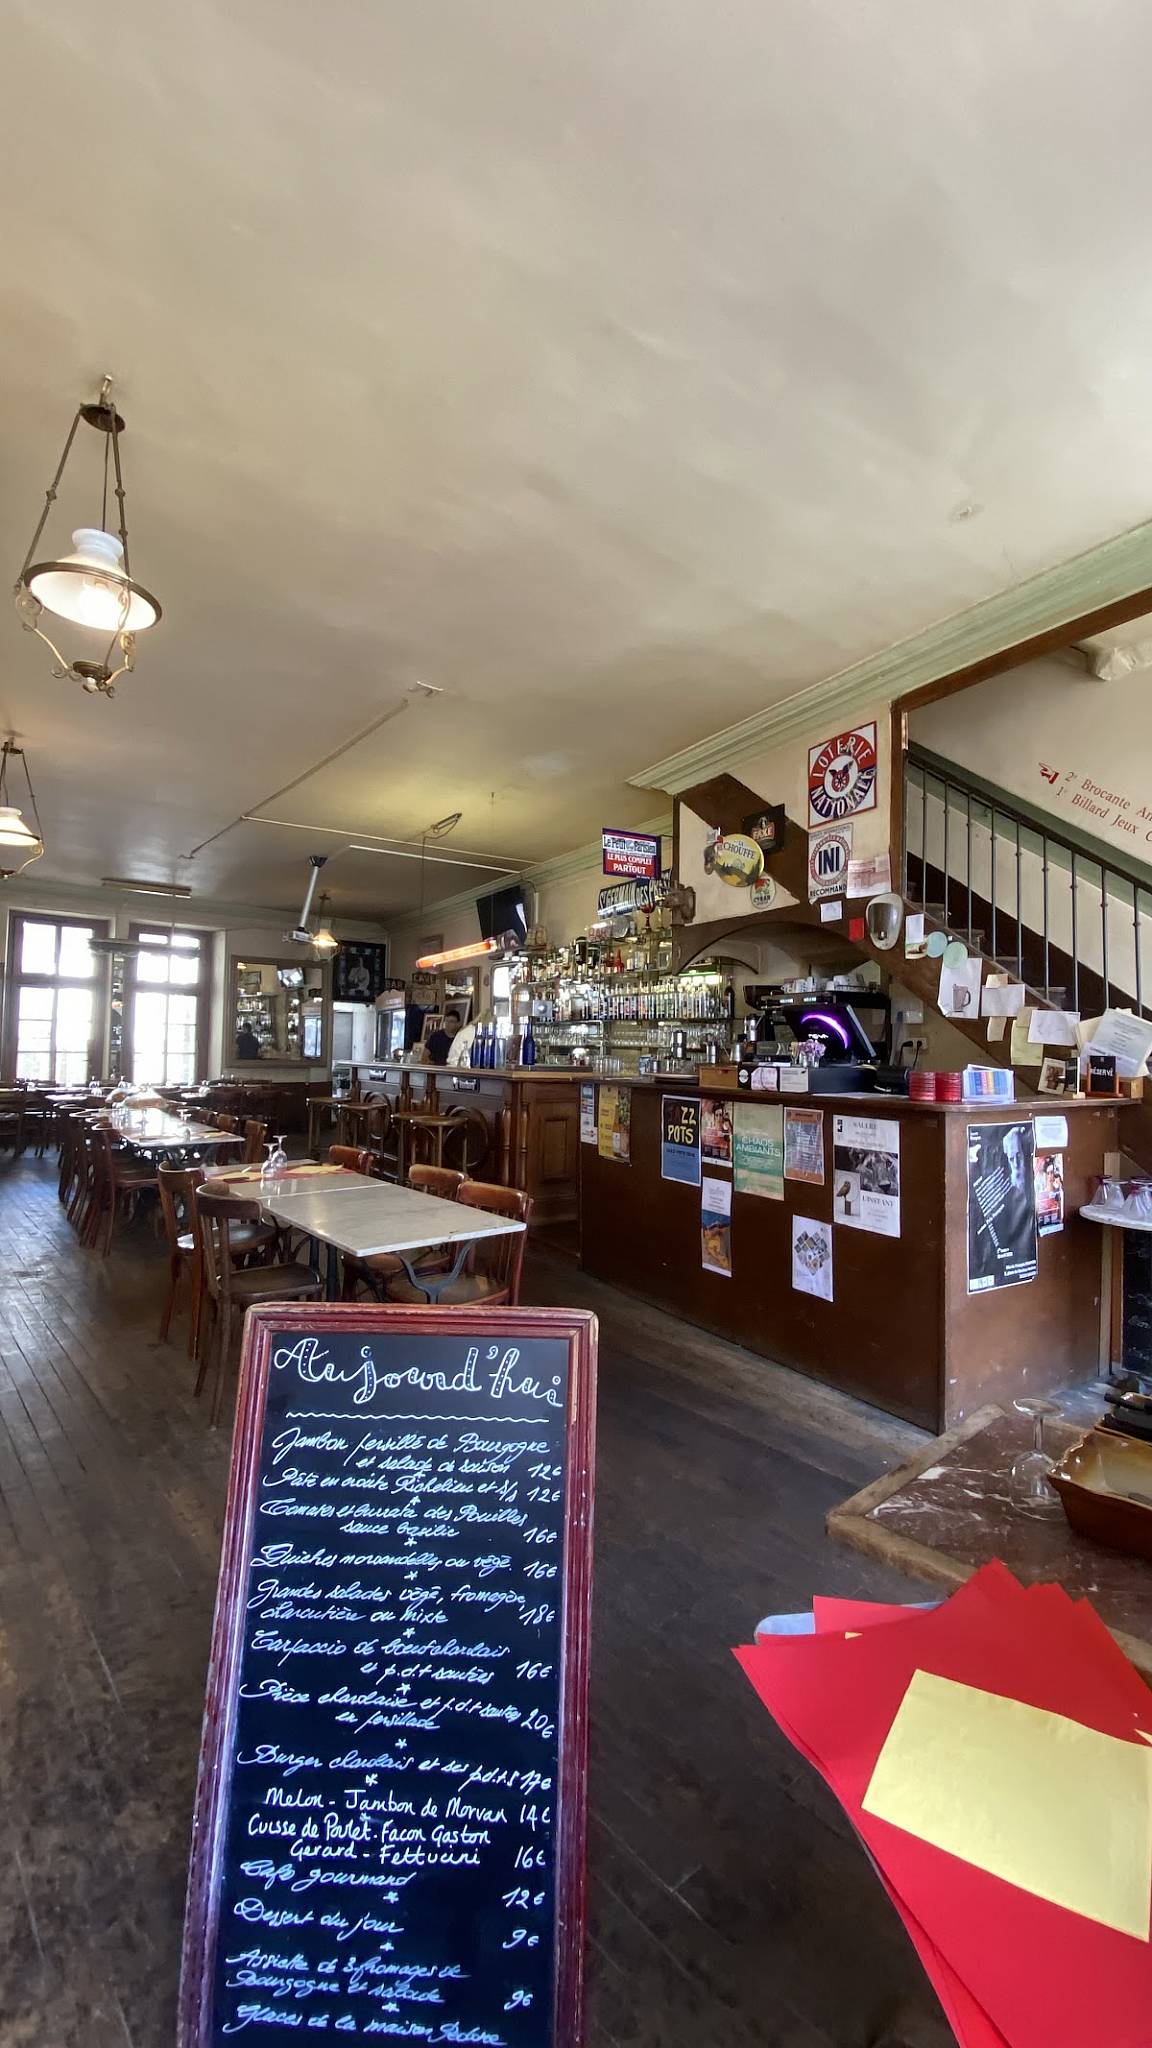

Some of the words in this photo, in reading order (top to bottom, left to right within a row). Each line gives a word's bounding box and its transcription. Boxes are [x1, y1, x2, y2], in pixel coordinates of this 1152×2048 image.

[812, 738, 872, 778] LOTERIE
[811, 767, 876, 817] NATIONALE
[1081, 779, 1131, 809] Brocante
[1071, 793, 1110, 819] Billard
[1111, 815, 1139, 834] Jeux
[628, 856, 653, 866] COMPLET
[723, 842, 755, 860] CHOUFFE
[818, 846, 840, 875] INI
[613, 863, 646, 875] PARTOUT
[667, 1124, 694, 1144] POTS
[741, 1136, 774, 1147] CHAOS
[736, 1142, 781, 1157] AMBIANTS
[272, 1427, 348, 1465] Jambon
[453, 1432, 550, 1464] Bourgogne
[356, 1456, 376, 1468] et
[377, 1455, 432, 1472] salade
[458, 1458, 510, 1474] saison
[320, 1476, 340, 1487] en
[391, 1475, 474, 1494] Richelieu
[477, 1481, 498, 1494] et
[527, 1487, 561, 1503] 12€
[424, 1505, 453, 1521] des
[340, 1520, 389, 1535] sauce
[396, 1521, 460, 1537] basilic
[523, 1527, 557, 1544] 16€
[250, 1543, 338, 1568] Quiches
[445, 1557, 470, 1568] ou
[523, 1561, 558, 1579] 16€
[325, 1581, 392, 1602] salades
[370, 1611, 396, 1622] ou
[400, 1608, 448, 1623] mixte
[519, 1604, 555, 1626] 18€
[251, 1630, 347, 1667] Carpaccio
[354, 1638, 379, 1655] de
[516, 1660, 553, 1679] 16€
[420, 1696, 441, 1709] et
[521, 1708, 554, 1738] 20€
[236, 1744, 323, 1777] Burger
[418, 1757, 440, 1770] et
[264, 1787, 325, 1808] Melon
[344, 1789, 416, 1815] Jambon
[420, 1797, 438, 1818] de
[445, 1796, 508, 1823] Morvan
[248, 1812, 297, 1836] Cuisse
[301, 1816, 320, 1838] de
[431, 1824, 492, 1848] Gaston
[290, 1839, 358, 1862] Gerard
[379, 1843, 481, 1865] Fettucini
[514, 1845, 546, 1869] 16€
[291, 1872, 417, 1892] gourmand
[320, 1912, 349, 1929] du
[337, 1912, 405, 1941] jour
[317, 1958, 339, 1974] de
[225, 1969, 340, 1998] Bourgogne
[504, 1990, 533, 2011] 9€
